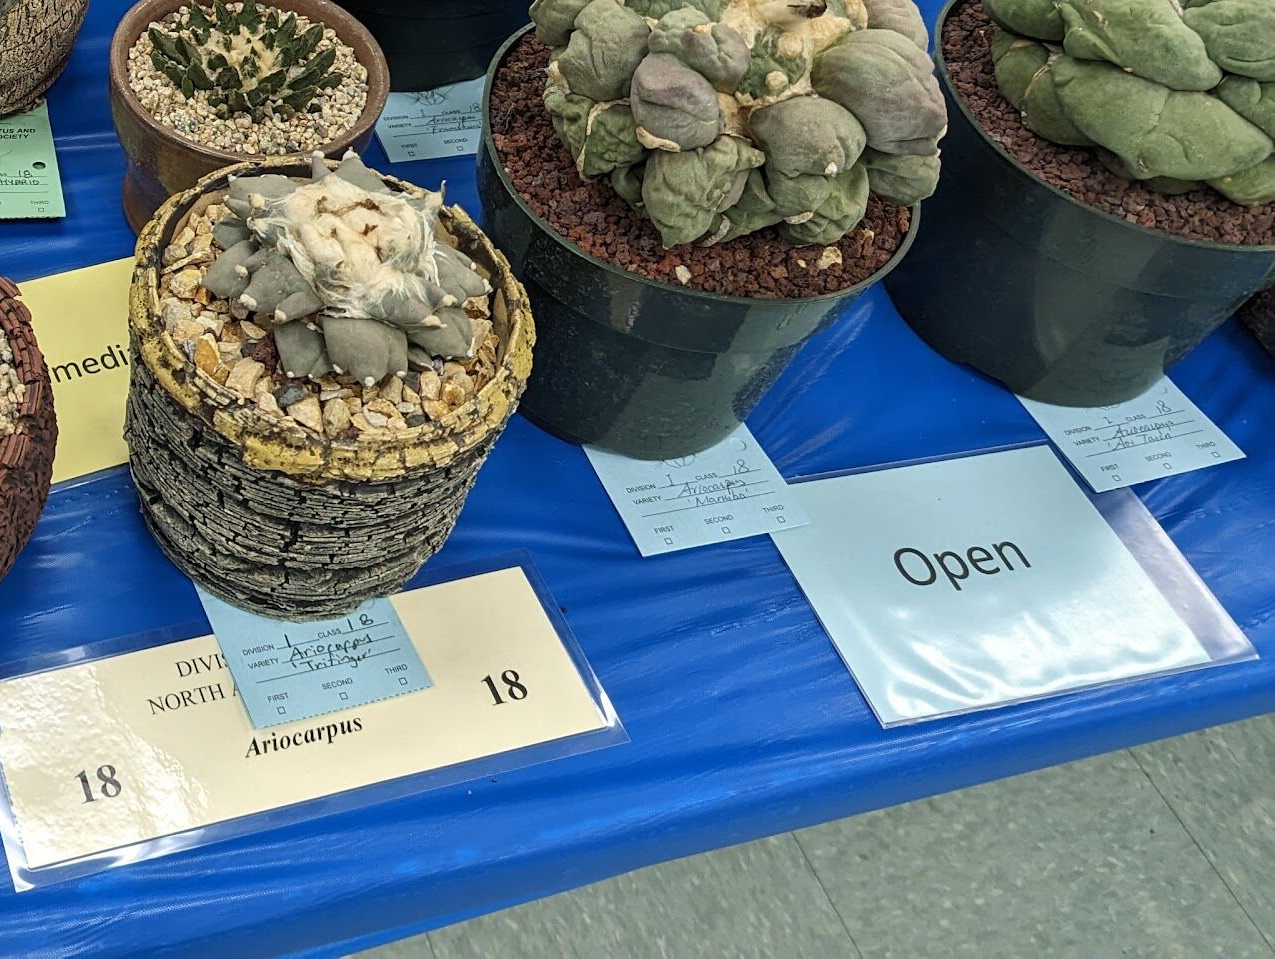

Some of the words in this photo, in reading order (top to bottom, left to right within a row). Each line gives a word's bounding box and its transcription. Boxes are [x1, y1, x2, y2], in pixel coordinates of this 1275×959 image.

[0, 178, 41, 187] HYBRID
[1156, 400, 1173, 415] 18
[1072, 436, 1100, 447] VARIETY
[1100, 462, 1120, 473] FIRST
[1144, 451, 1173, 463] SECOND
[1195, 440, 1217, 451] THIRD
[626, 483, 657, 494] DIVISION
[694, 471, 719, 482] CLASS
[733, 458, 751, 475] 18
[632, 494, 663, 506] VARIETY
[653, 524, 675, 535] FIRST
[703, 513, 735, 526] SECOND
[762, 503, 785, 515] THIRD
[893, 539, 1032, 592] Open
[242, 642, 276, 657] DIVISION
[317, 627, 343, 641] CLASS
[347, 613, 374, 632] 18
[175, 651, 229, 680] DIVIS
[247, 657, 280, 671] VARIETY
[146, 683, 226, 716] NORTH
[266, 692, 290, 704] FIRST
[320, 677, 354, 691] SECOND
[384, 662, 409, 677] THIRD
[480, 668, 529, 707] 18
[244, 714, 363, 759] Ariocarpus
[73, 764, 123, 805] 18
